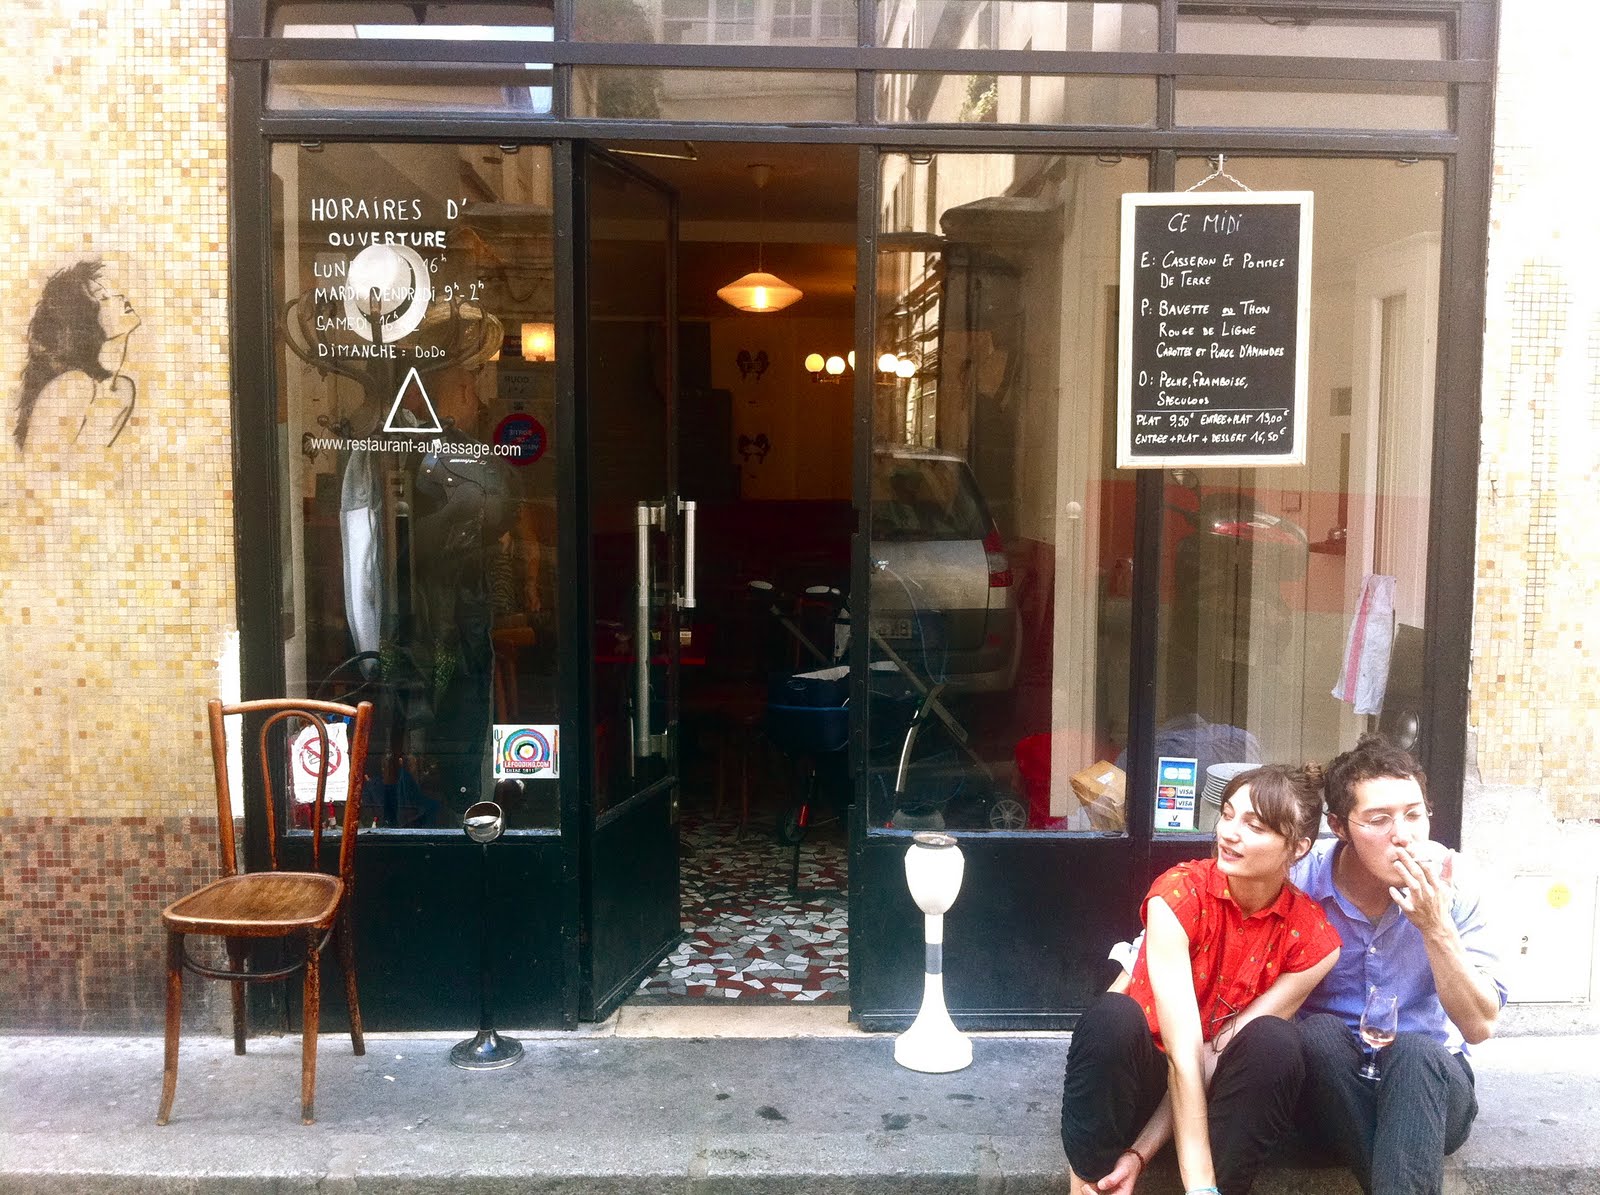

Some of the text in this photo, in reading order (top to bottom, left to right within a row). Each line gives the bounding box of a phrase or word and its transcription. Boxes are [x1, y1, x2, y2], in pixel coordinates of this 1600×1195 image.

[1168, 212, 1190, 233] CE
[328, 231, 447, 249] OUVERTURE
[1162, 251, 1216, 268] CASSERON
[1161, 270, 1211, 289] DE TERRE
[1159, 300, 1210, 316] BAVETTE
[1240, 300, 1270, 315] THON
[1159, 322, 1194, 337] ROUGE
[1203, 327, 1214, 336] DE
[1136, 414, 1162, 426] PLAT
[311, 437, 522, 458] www.restaurant-aupassage.com
